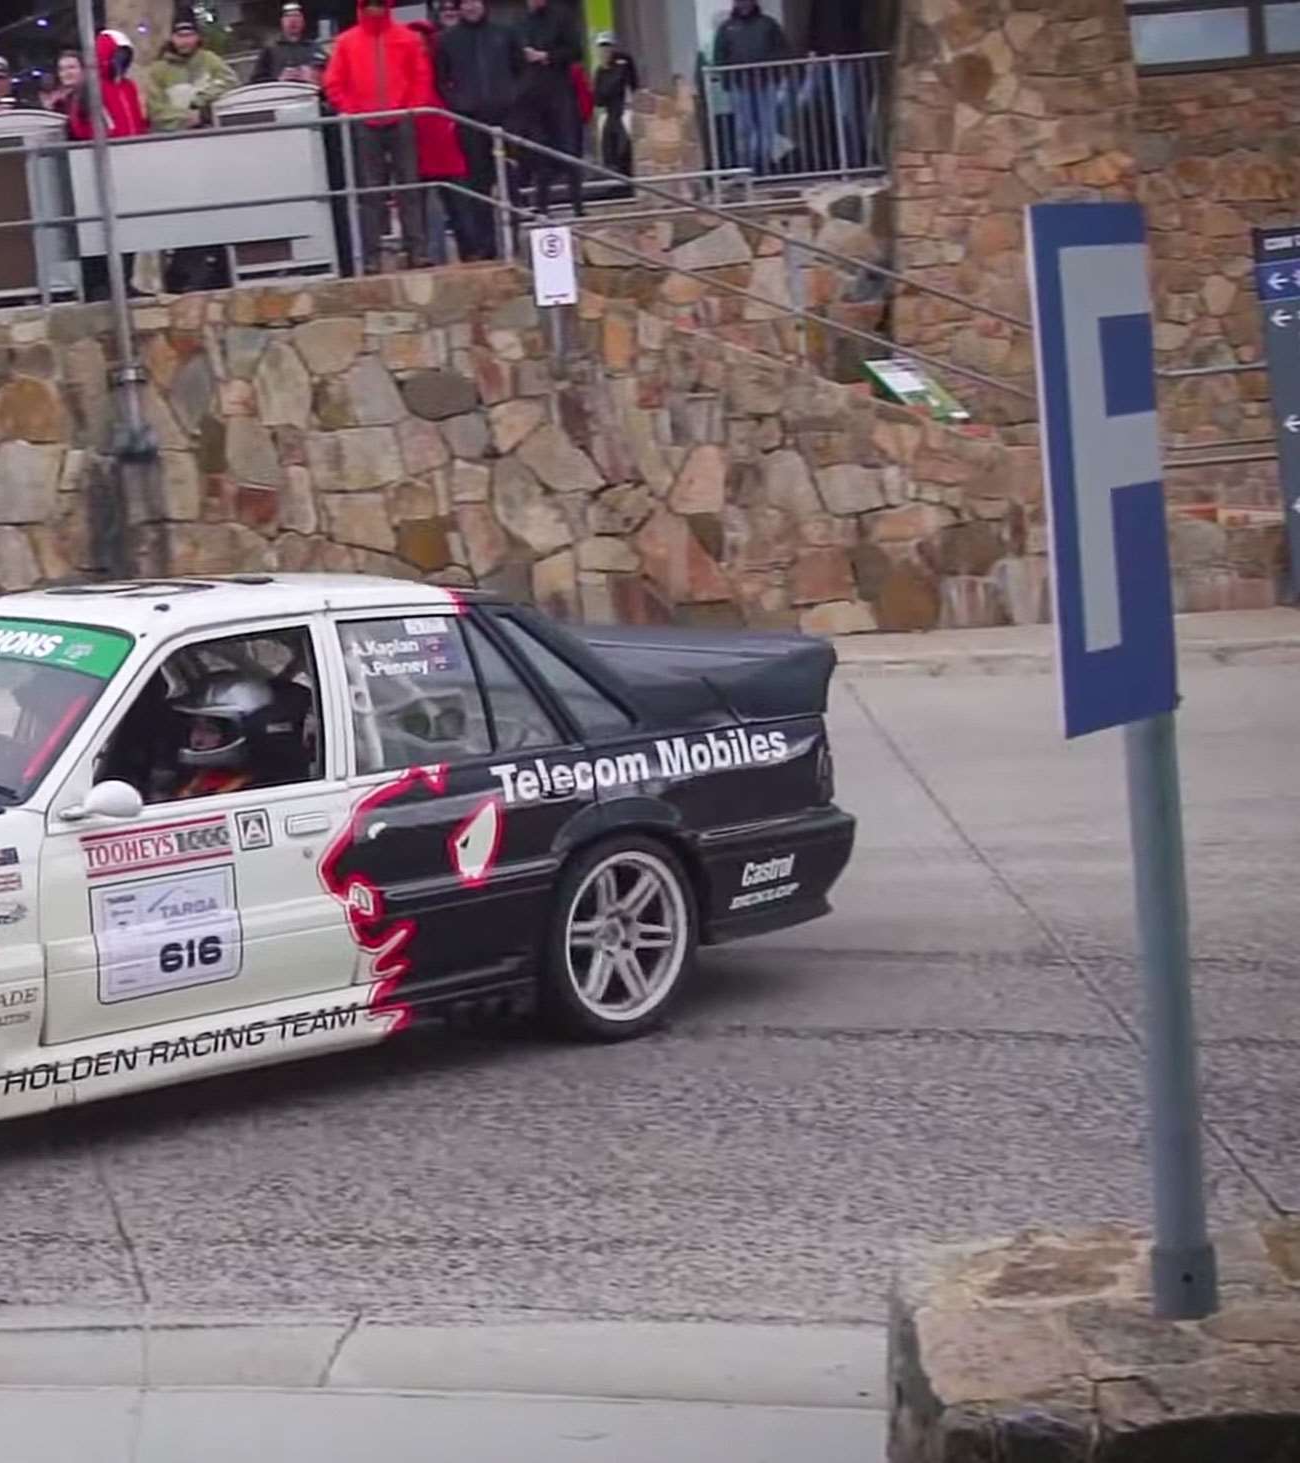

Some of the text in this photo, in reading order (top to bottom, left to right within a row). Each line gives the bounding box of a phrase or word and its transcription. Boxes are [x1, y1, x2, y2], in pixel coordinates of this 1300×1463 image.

[490, 728, 788, 803] Telecom Mobiles
[84, 825, 231, 868] TOOHEYS 1000
[741, 853, 795, 887] Castrol
[159, 897, 219, 919] TARGA
[159, 935, 223, 974] 616
[3, 1001, 360, 1095] HOLDEN RACING TEAM
